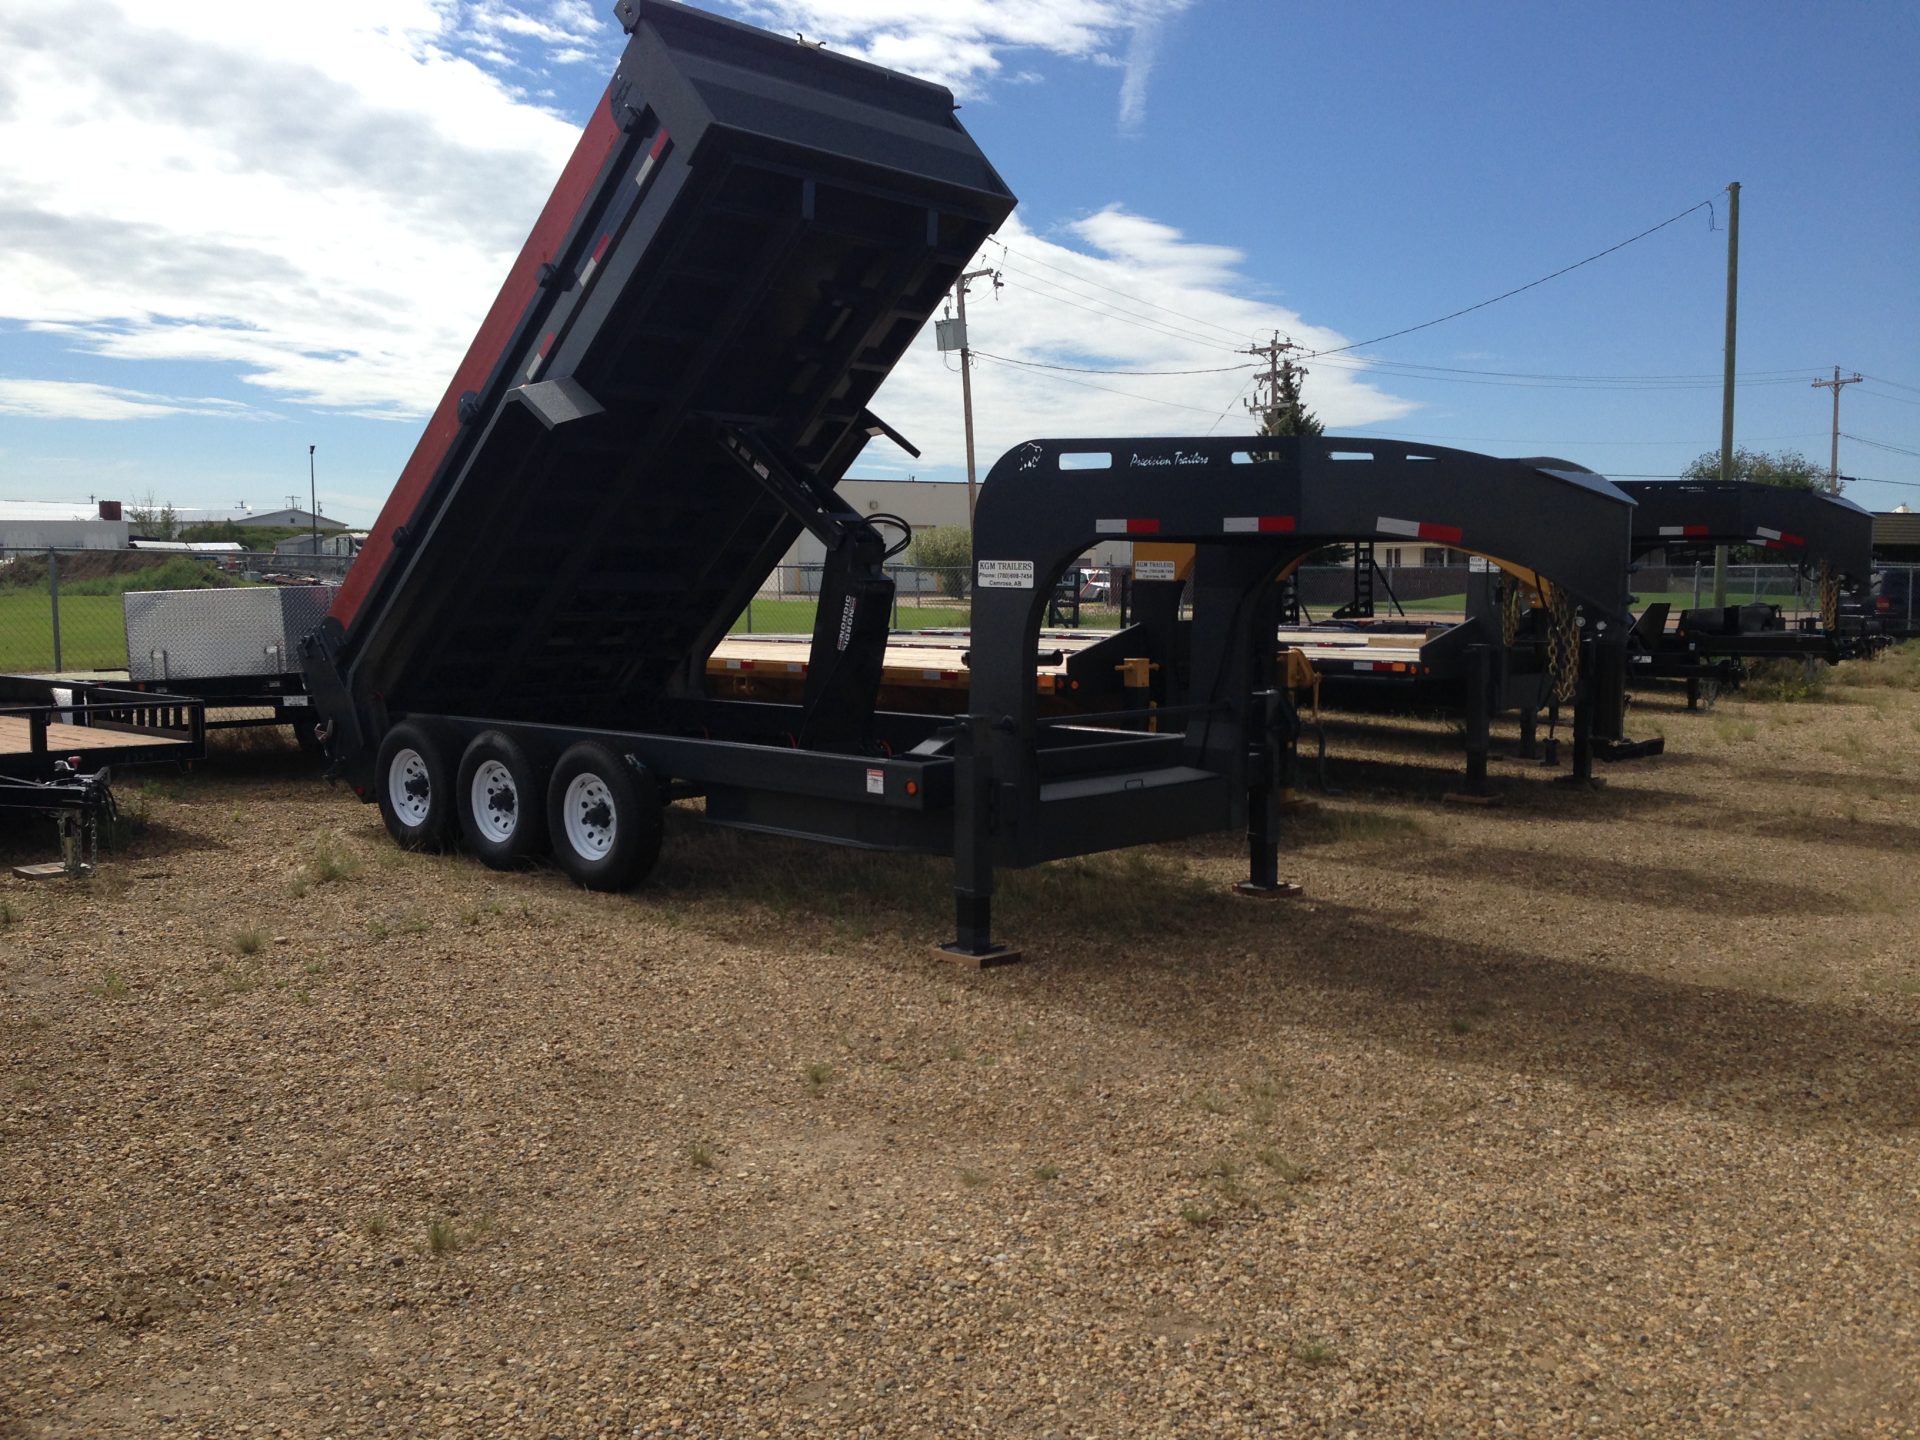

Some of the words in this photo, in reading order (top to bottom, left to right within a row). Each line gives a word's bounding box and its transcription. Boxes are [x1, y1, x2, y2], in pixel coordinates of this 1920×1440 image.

[1129, 453, 1172, 467] Precision
[1174, 451, 1209, 465] Trailers
[979, 562, 996, 570] KGM
[997, 562, 1032, 571] TRAILERS
[839, 595, 851, 642] NORDIC
[842, 607, 855, 652] NORDIC
